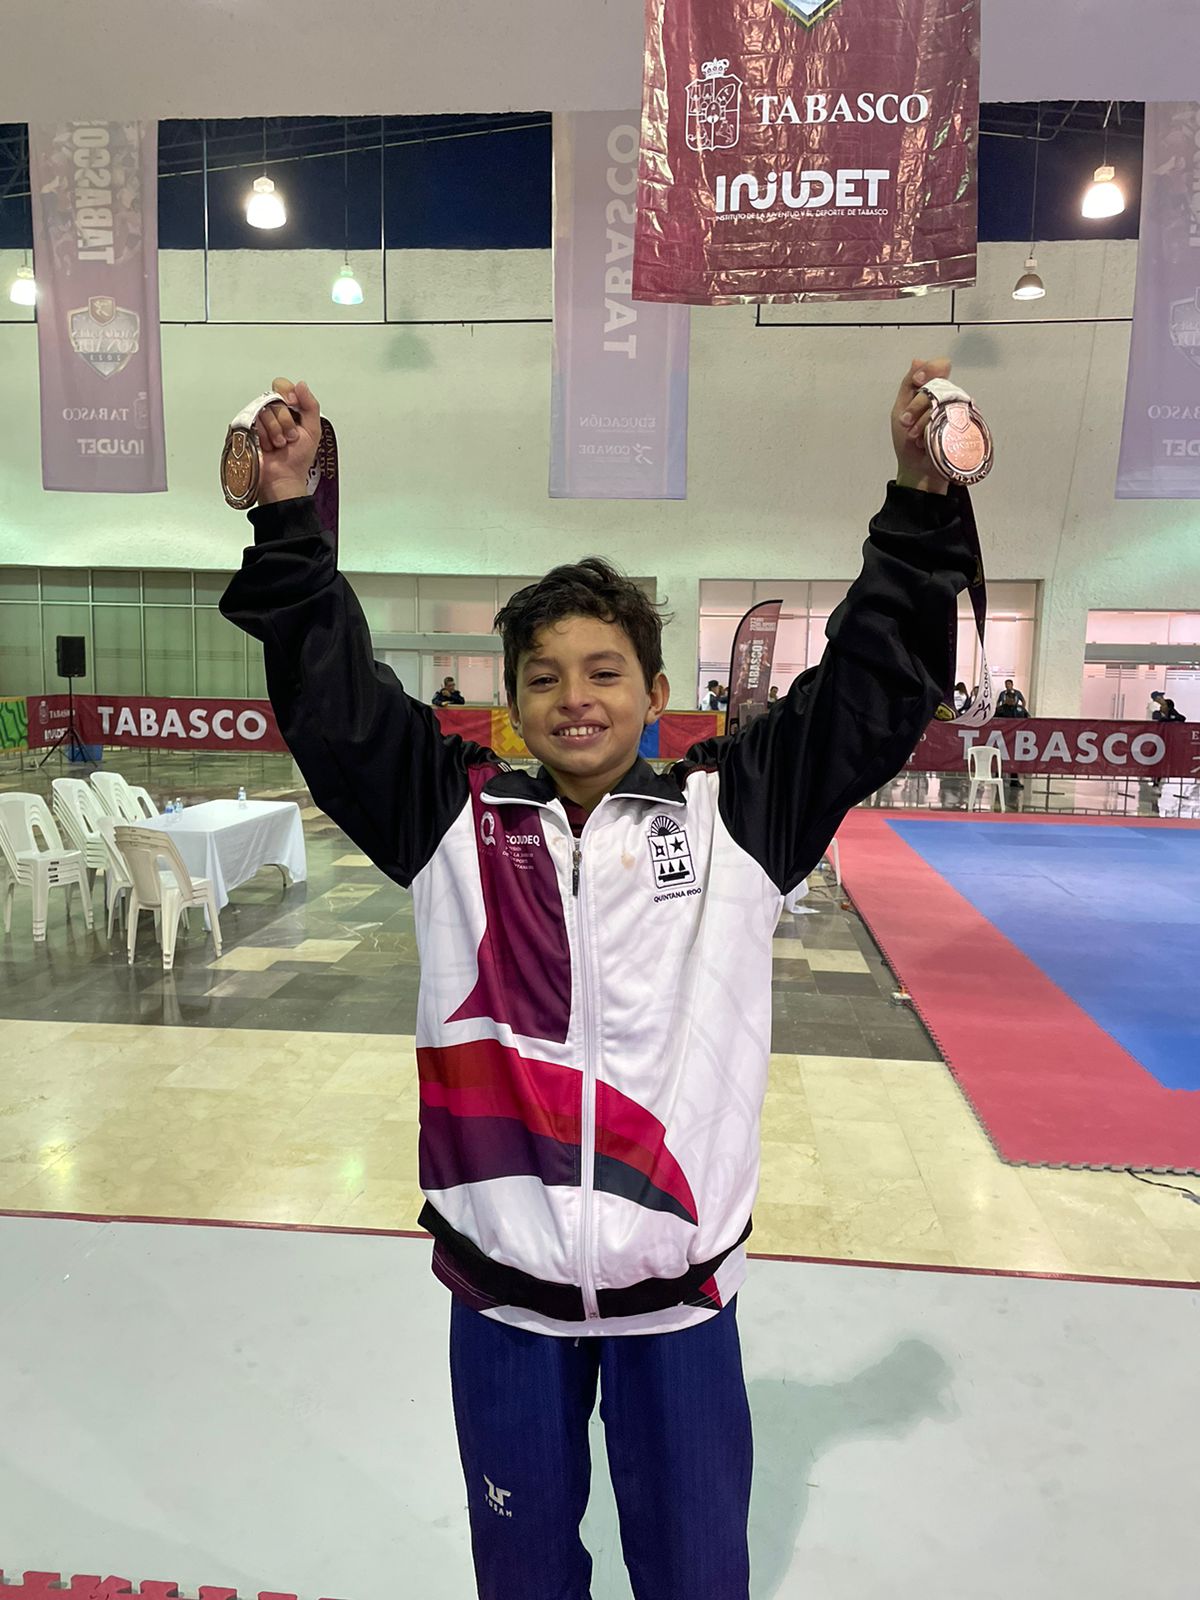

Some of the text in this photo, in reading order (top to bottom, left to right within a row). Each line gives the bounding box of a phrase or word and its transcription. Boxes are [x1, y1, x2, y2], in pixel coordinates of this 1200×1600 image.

[755, 92, 930, 125] TABASCO
[746, 212, 756, 220] DE
[815, 209, 845, 218] DEPORTE
[847, 208, 857, 216] DE
[857, 208, 889, 216] TABASCO
[748, 646, 763, 689] TABASCO
[97, 706, 268, 741] TABASCO
[958, 729, 1166, 766] TABASCO
[654, 891, 686, 903] QUINTANA
